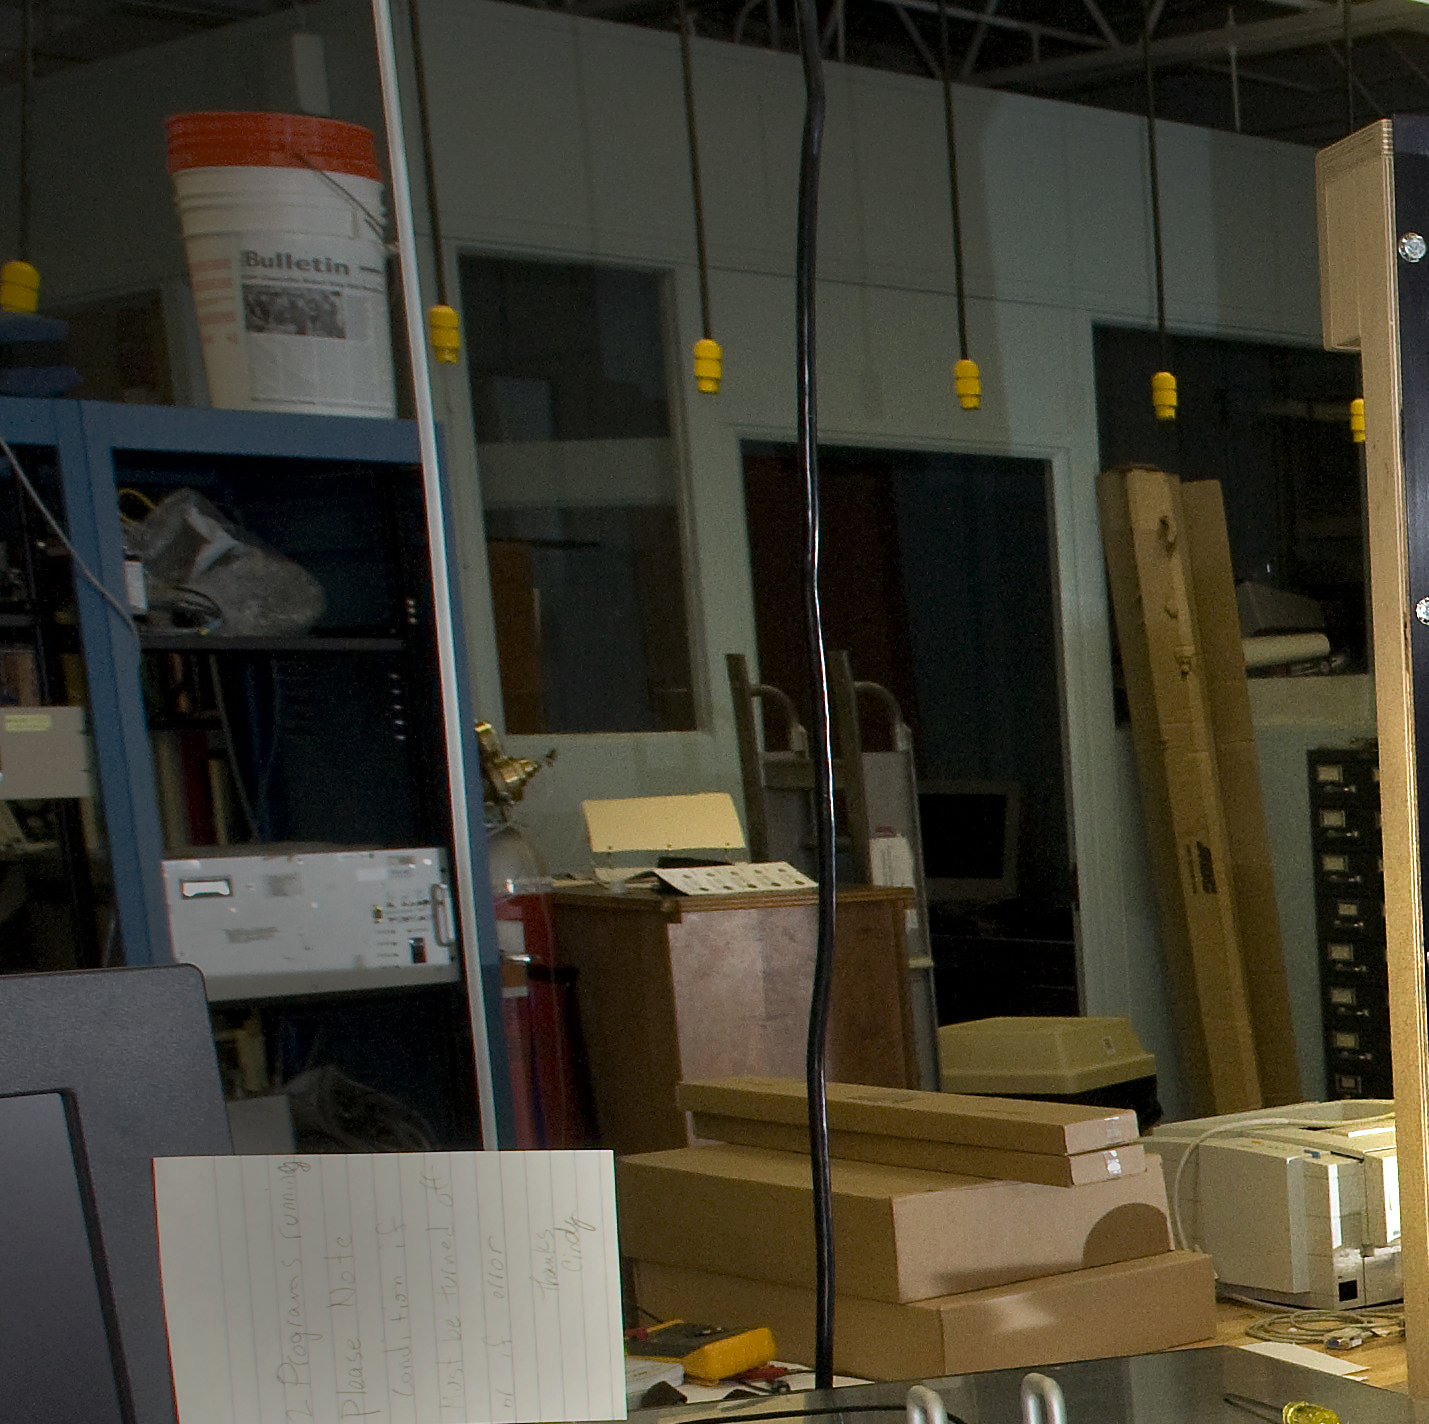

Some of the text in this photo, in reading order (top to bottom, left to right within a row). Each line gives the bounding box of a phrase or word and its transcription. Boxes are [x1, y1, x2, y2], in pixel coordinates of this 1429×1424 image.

[243, 251, 350, 276] Bulletin
[325, 1235, 381, 1419] Please Note
